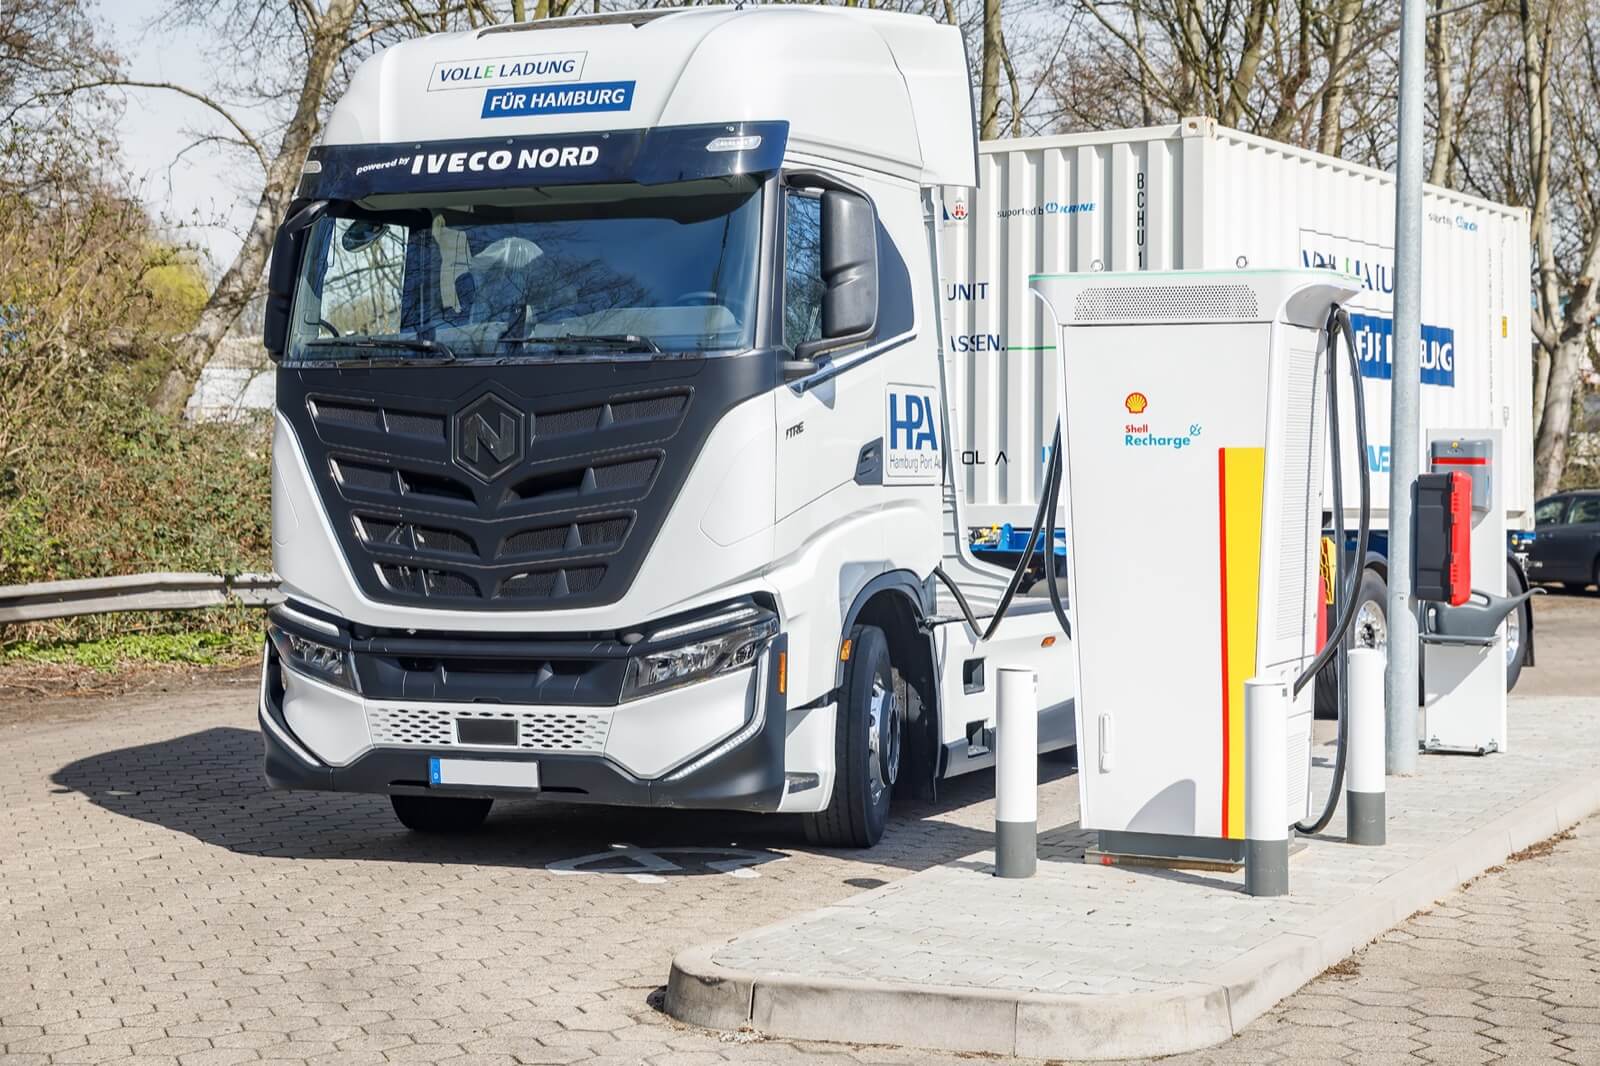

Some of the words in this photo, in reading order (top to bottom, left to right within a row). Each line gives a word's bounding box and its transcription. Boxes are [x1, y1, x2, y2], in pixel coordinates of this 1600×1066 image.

[440, 65, 495, 82] VOLLE
[499, 59, 576, 77] LADUNG
[490, 92, 526, 111] FÜR
[530, 88, 626, 109] HAMBURG
[355, 158, 398, 176] powered
[398, 156, 410, 166] by
[411, 150, 513, 175] IVECO
[517, 146, 600, 169] NORD
[889, 393, 939, 450] HPA
[1125, 424, 1149, 434] Shell
[1125, 433, 1191, 449] Recharge
[889, 454, 919, 473] Hamburg
[920, 454, 933, 469] Port
